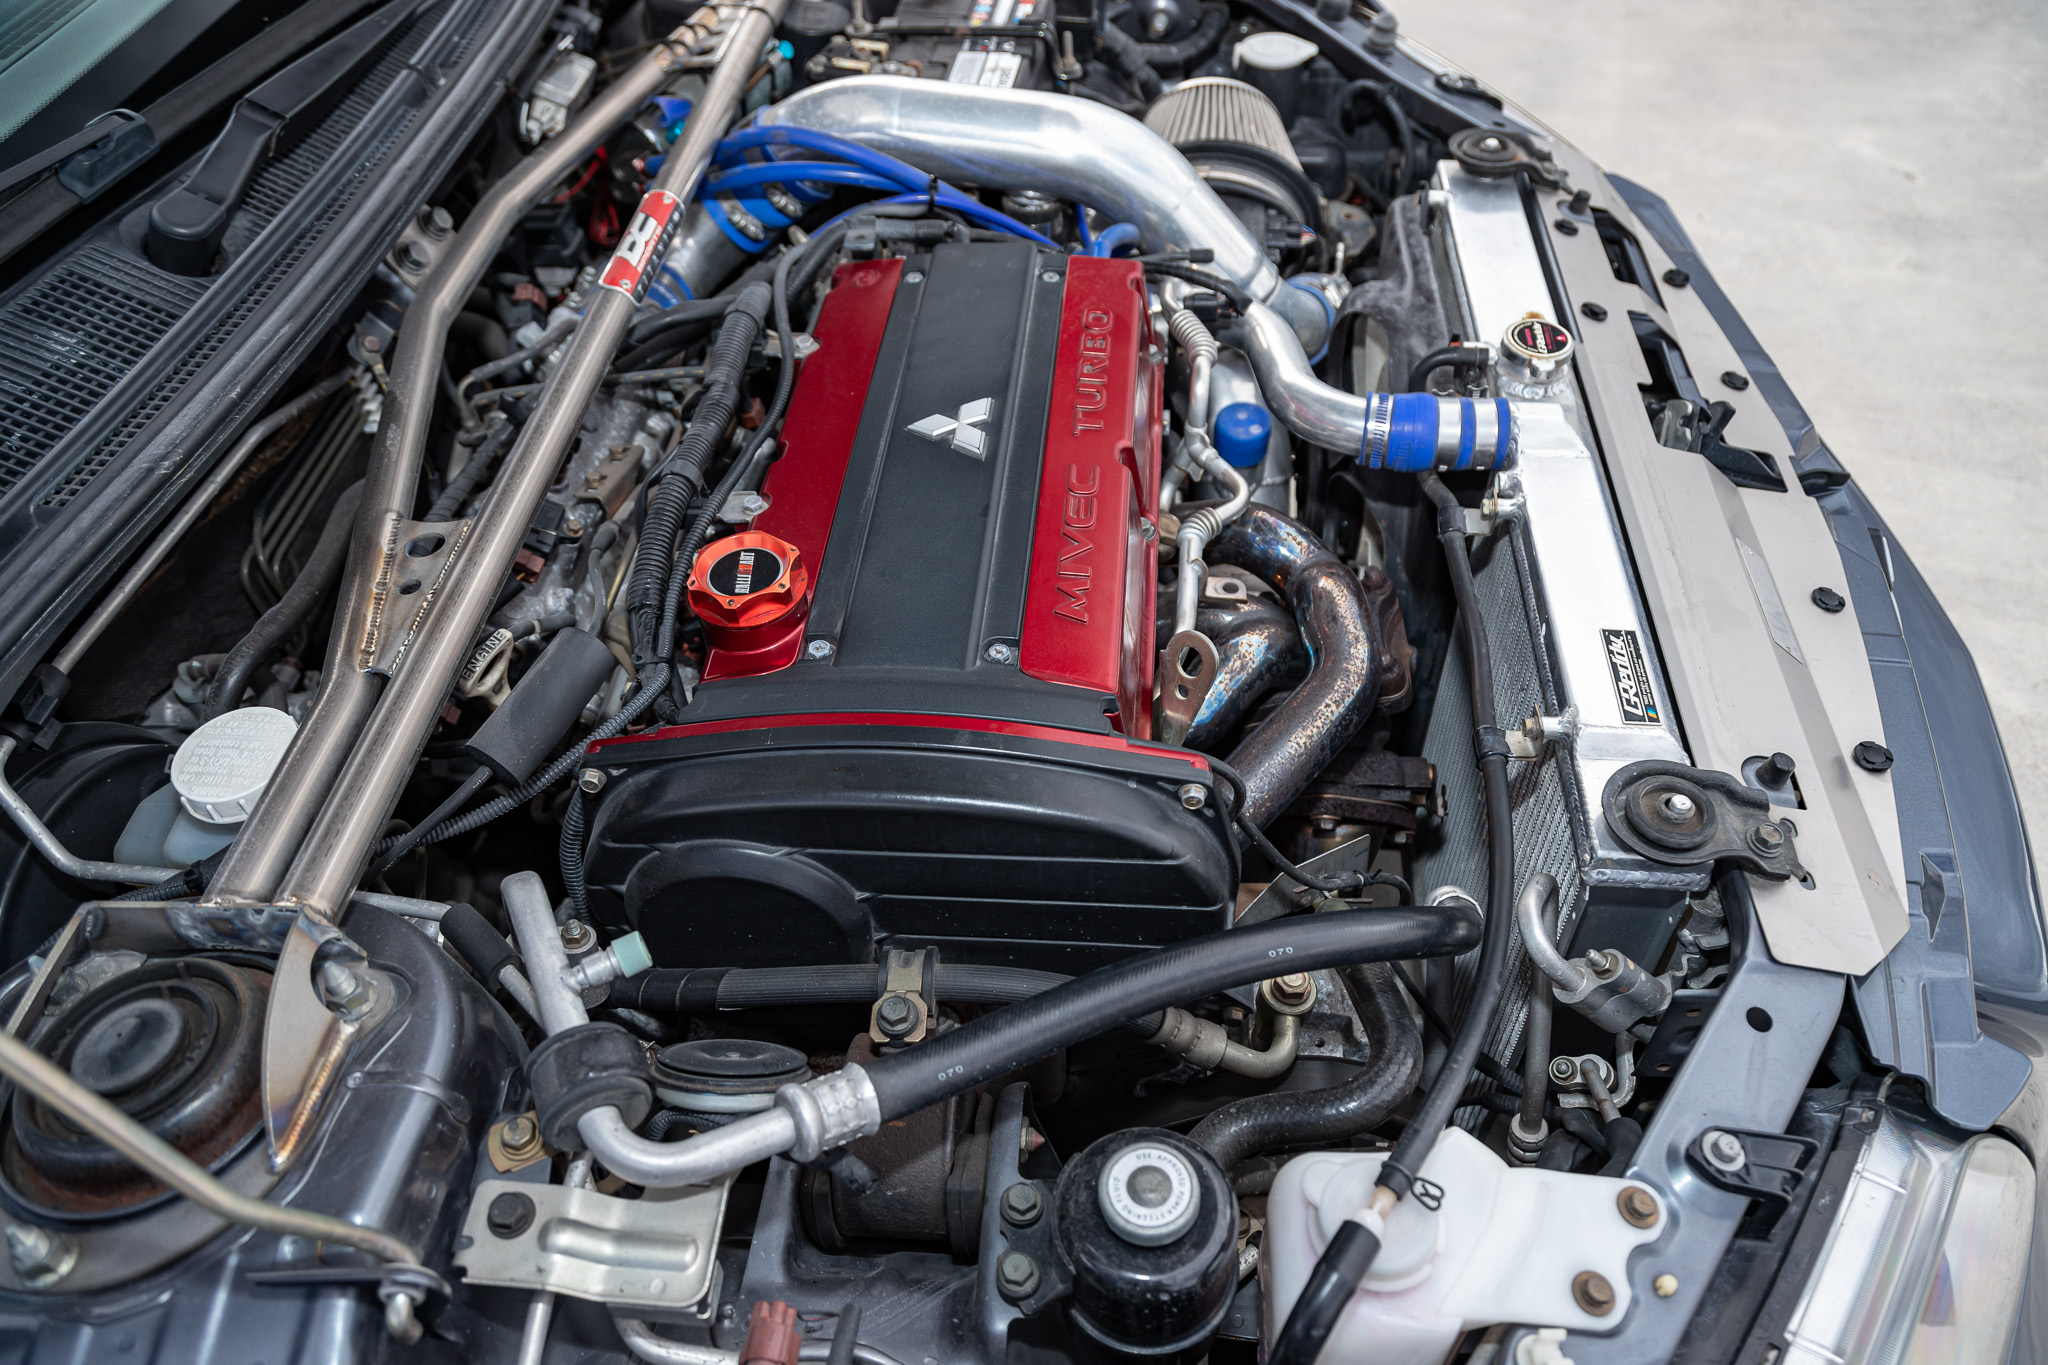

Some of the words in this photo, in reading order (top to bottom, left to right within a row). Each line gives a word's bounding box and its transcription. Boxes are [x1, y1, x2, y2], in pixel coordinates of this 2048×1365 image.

[616, 211, 658, 267] DC
[636, 224, 663, 273] SPORTS
[1072, 306, 1113, 437] TURBO
[1054, 463, 1100, 624] MIVEC
[734, 551, 755, 594] RALLIART
[461, 630, 507, 680] ENGINE
[1608, 634, 1643, 716] GReddy
[194, 747, 216, 755] from
[199, 739, 240, 748] container
[200, 756, 229, 765] DOT-3
[218, 748, 238, 758] fluid
[242, 750, 273, 759] DOT-4
[177, 772, 194, 781] cap
[183, 765, 228, 774] removing
[201, 774, 226, 784] filler
[189, 785, 232, 796] WARNING
[1136, 1152, 1152, 1160] USE
[1157, 1154, 1186, 1187] APPROVED
[1112, 1176, 1123, 1203] FLUID
[1167, 1190, 1185, 1215] POWER
